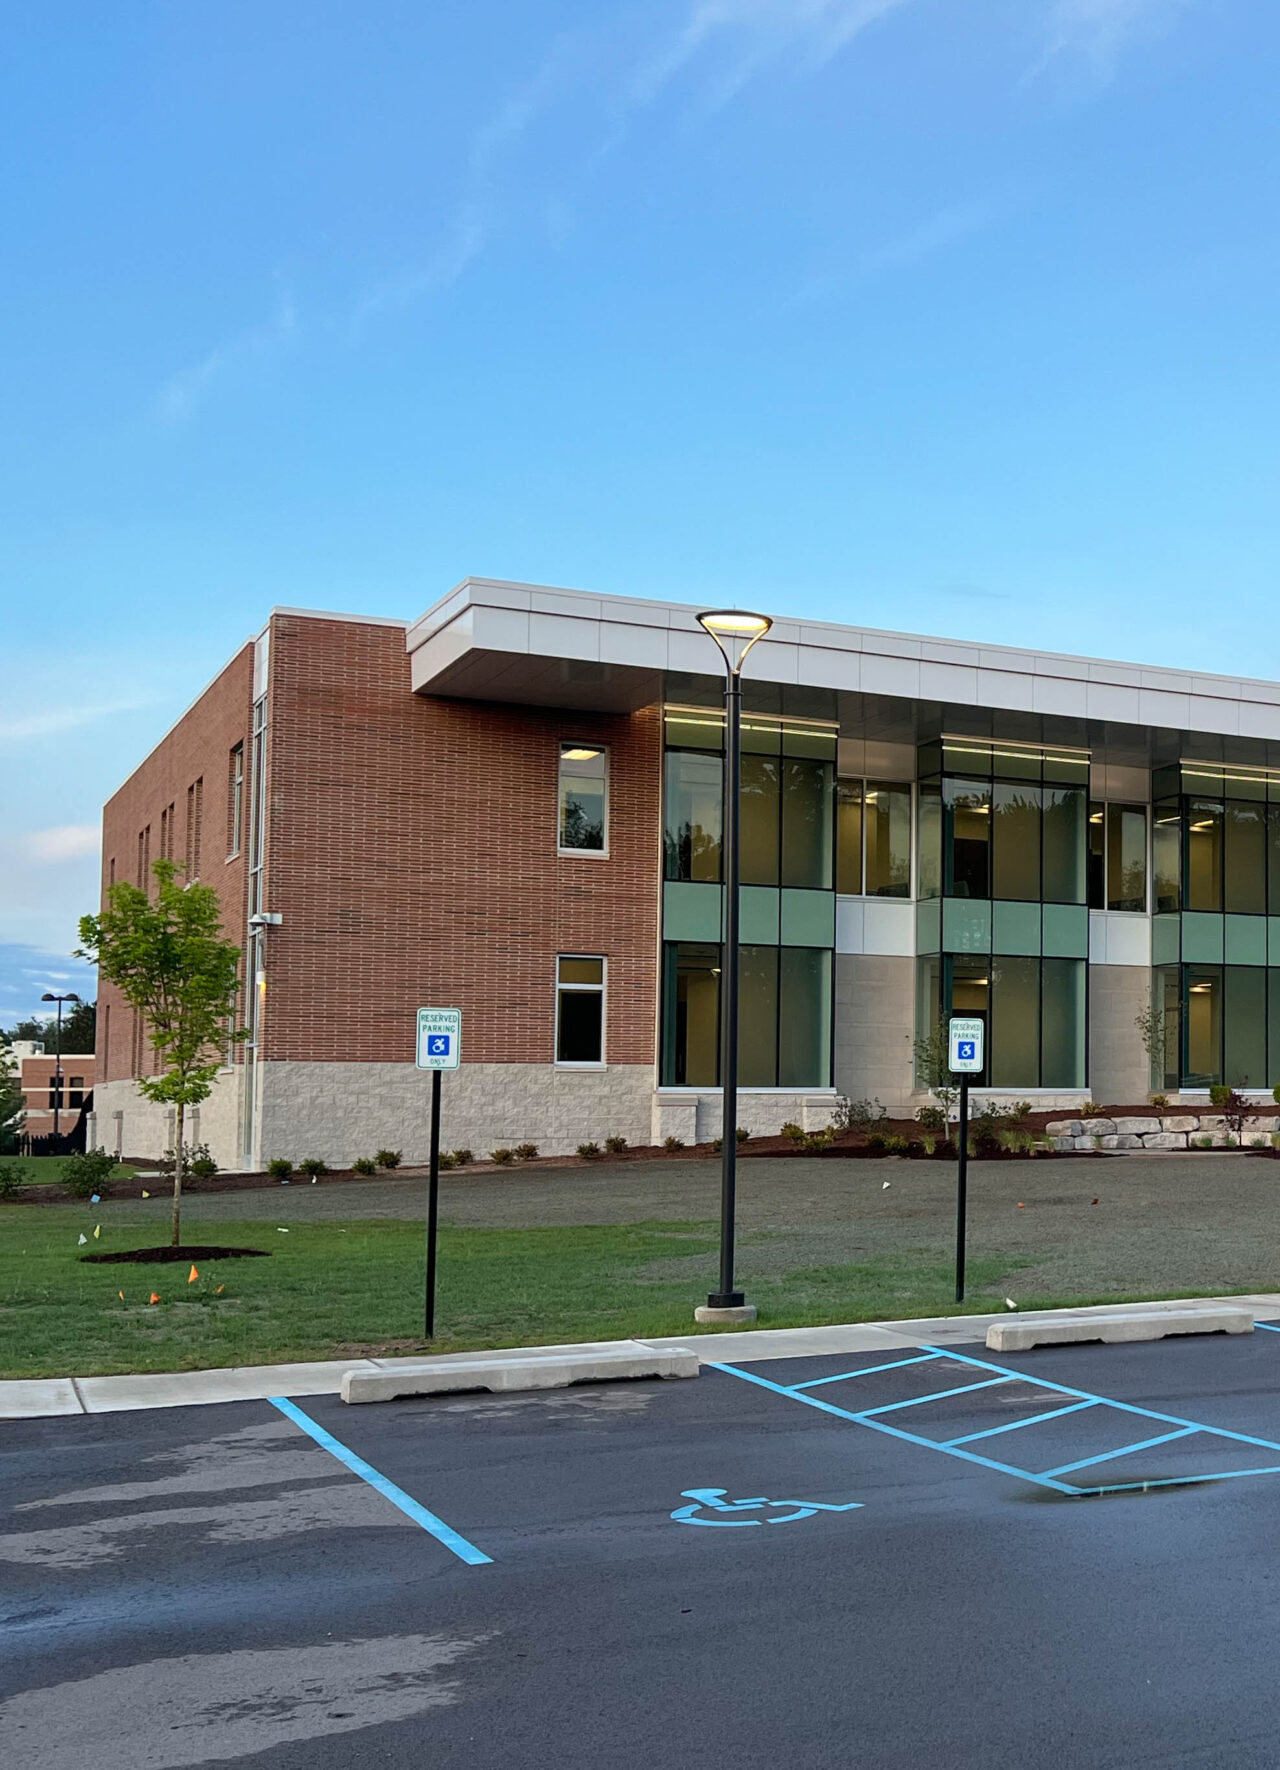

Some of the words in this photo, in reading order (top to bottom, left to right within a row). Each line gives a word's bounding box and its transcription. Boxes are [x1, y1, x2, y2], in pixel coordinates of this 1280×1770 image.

[420, 1014, 458, 1023] RESERVED
[422, 1024, 456, 1033] PARKING
[952, 1023, 981, 1031] RESERVED
[953, 1032, 980, 1040] PARKING
